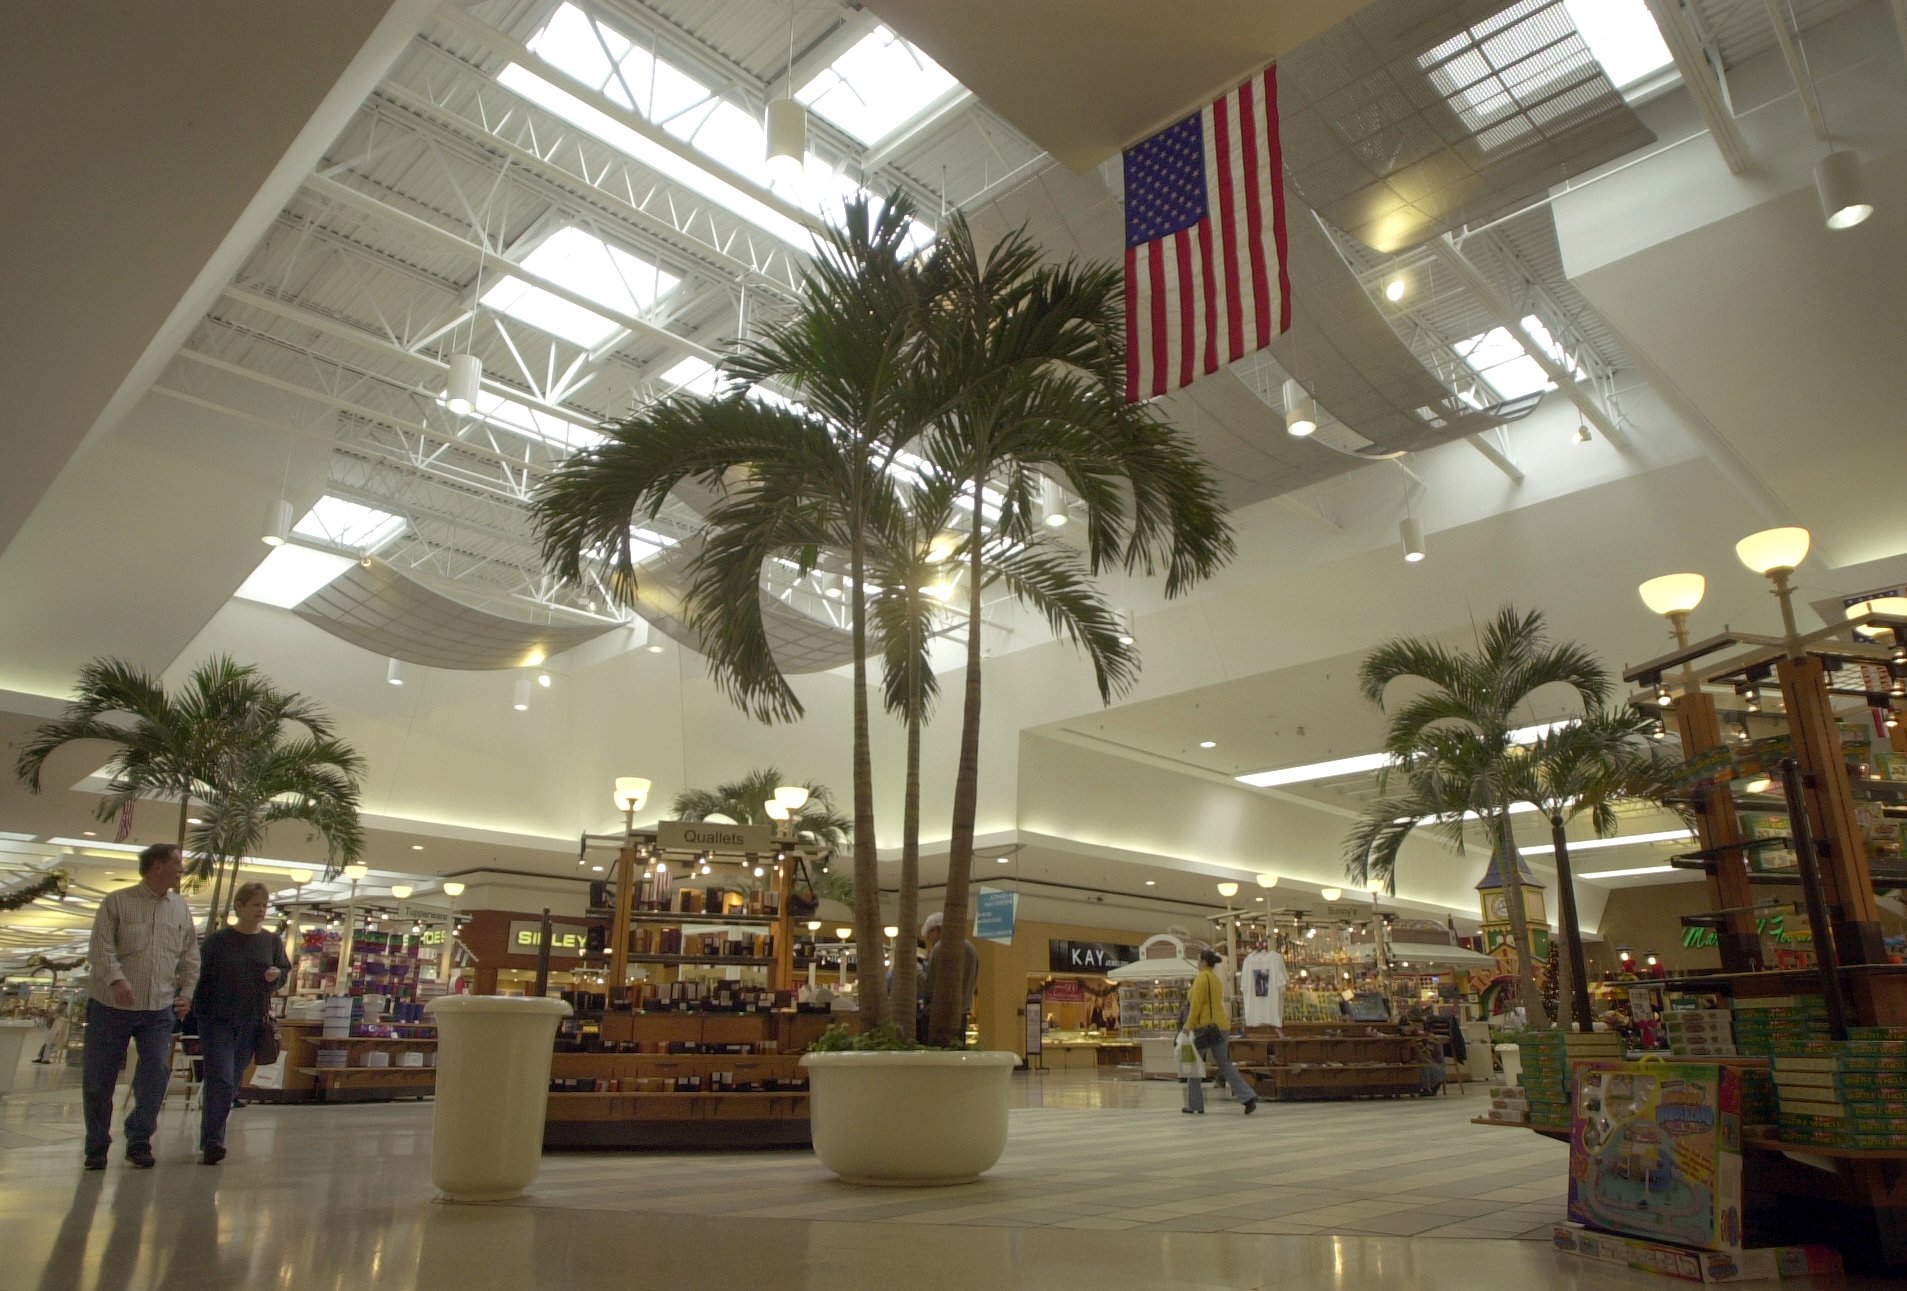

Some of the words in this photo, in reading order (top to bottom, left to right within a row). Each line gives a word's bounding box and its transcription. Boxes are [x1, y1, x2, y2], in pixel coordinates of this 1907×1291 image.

[684, 829, 744, 845] Quallets
[405, 906, 448, 920] Tupperware
[517, 930, 587, 948] SILEY
[1071, 948, 1104, 967] KAY
